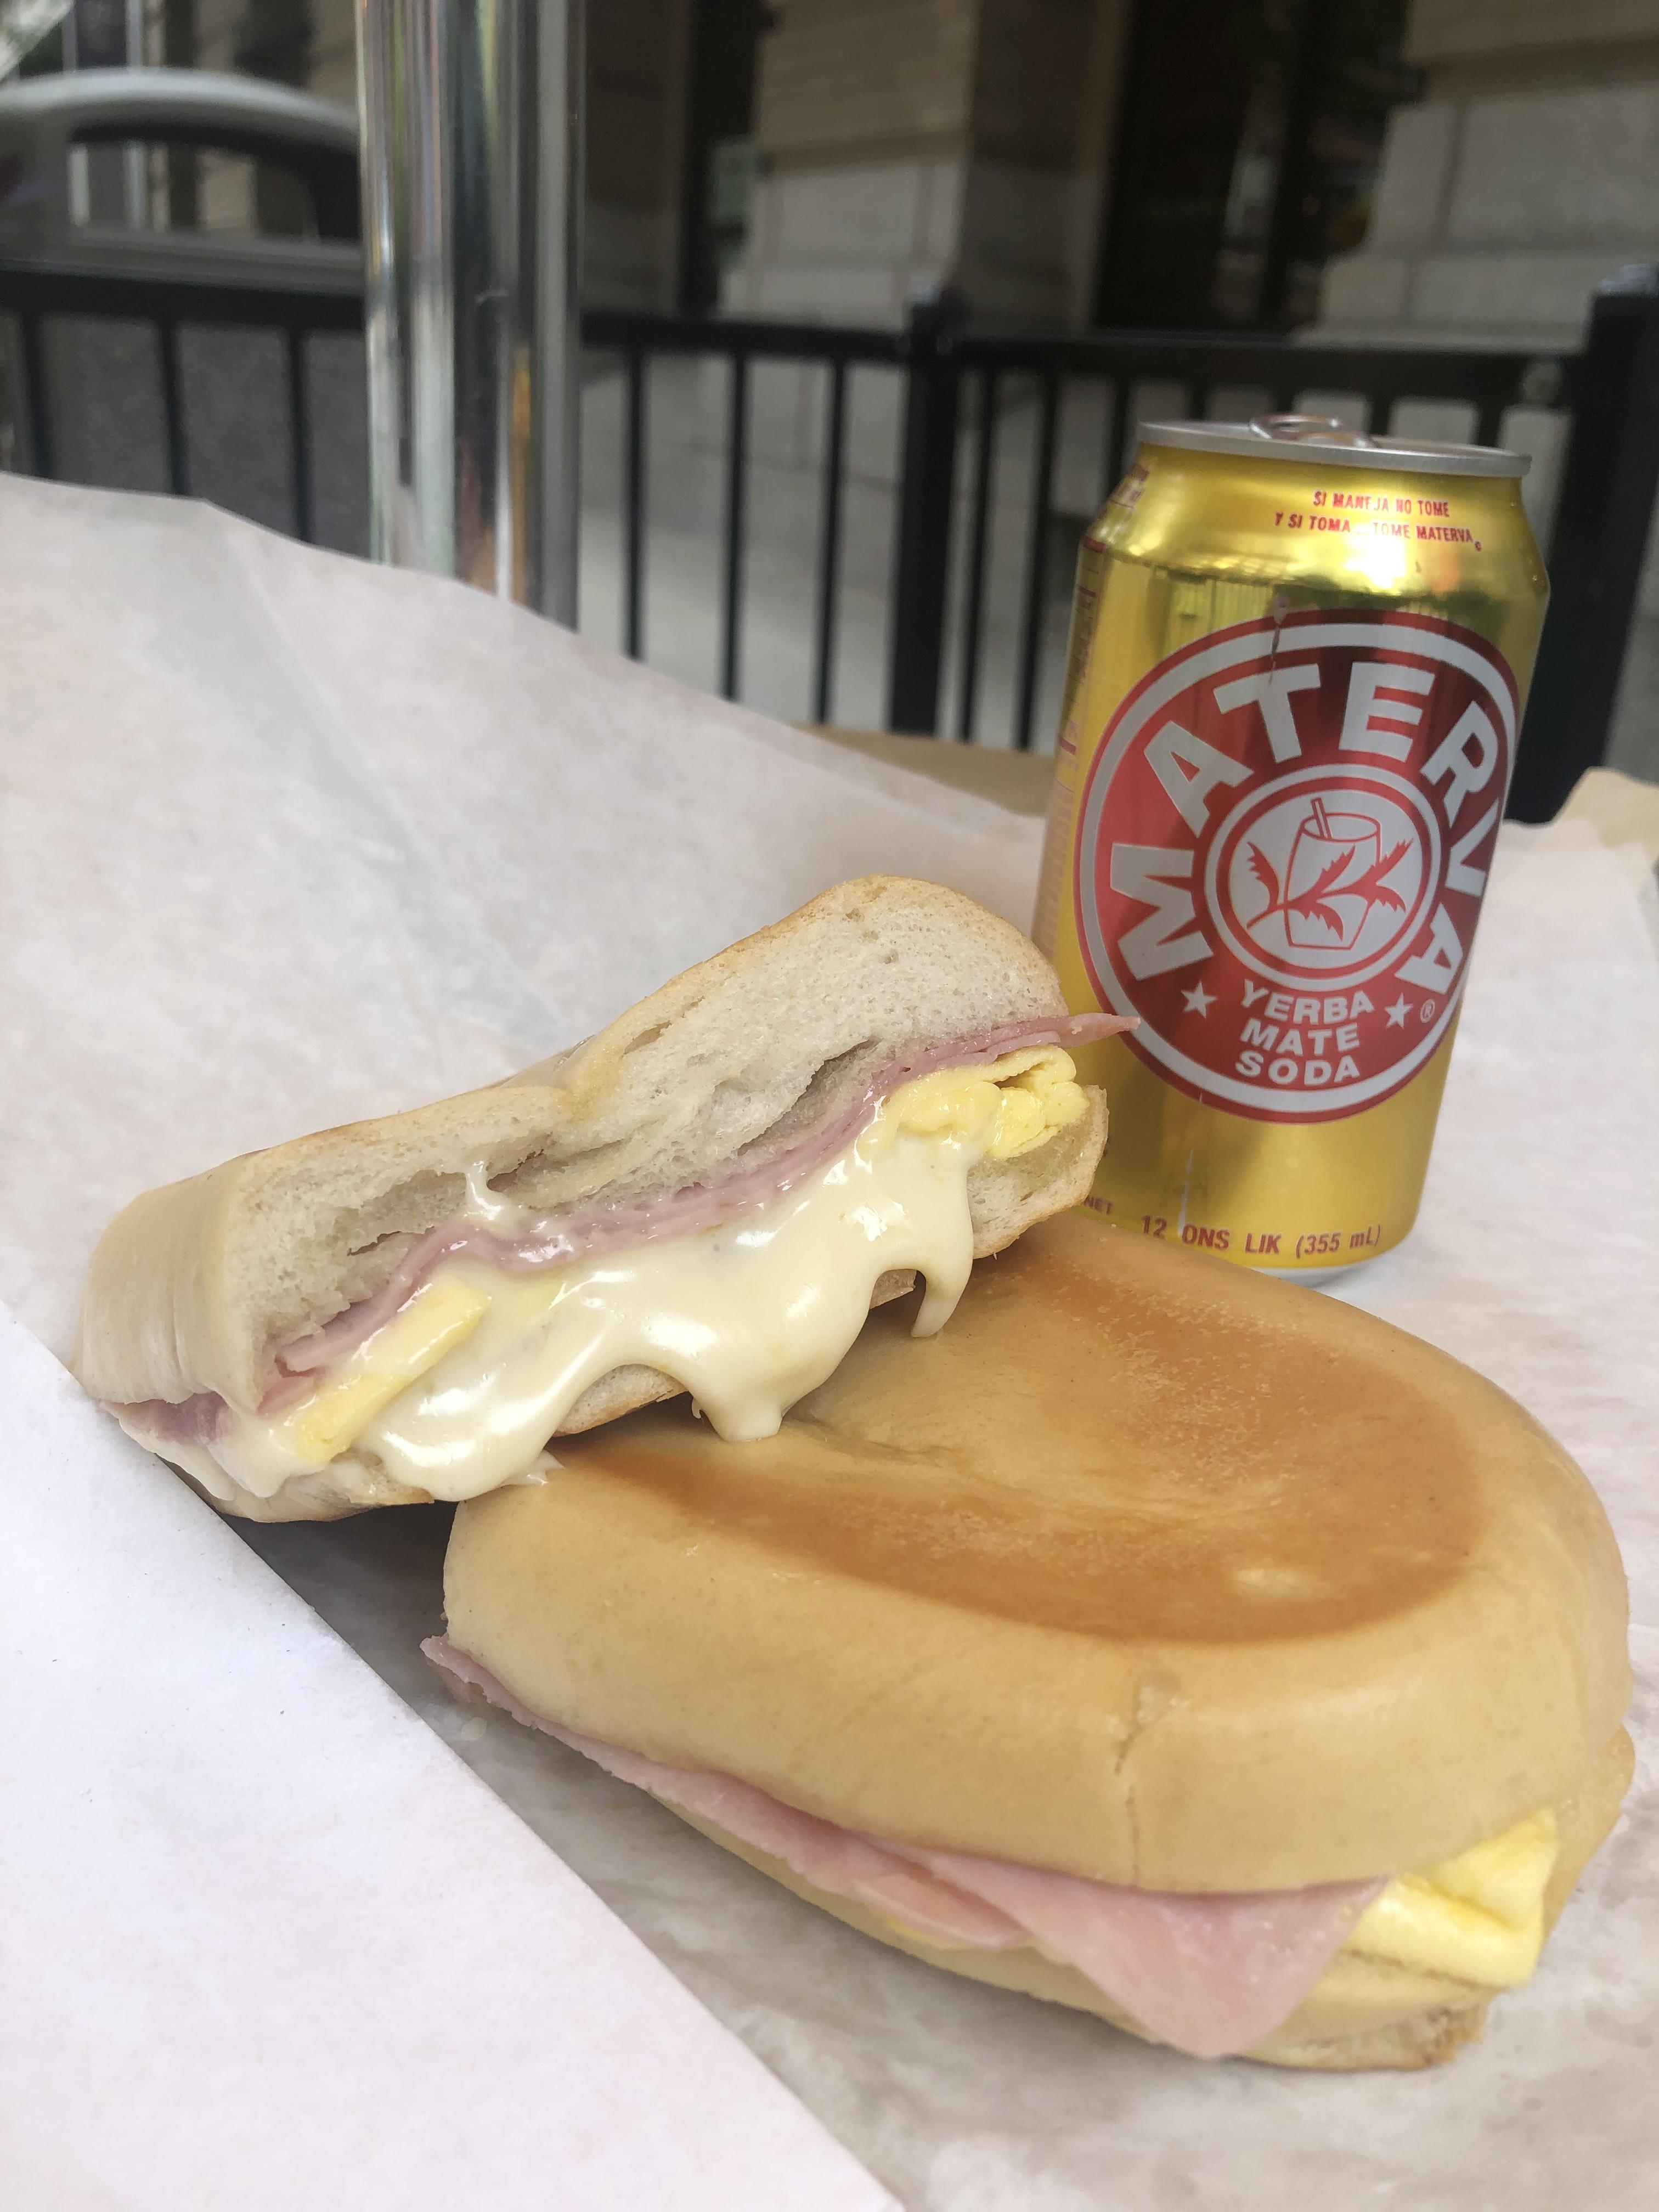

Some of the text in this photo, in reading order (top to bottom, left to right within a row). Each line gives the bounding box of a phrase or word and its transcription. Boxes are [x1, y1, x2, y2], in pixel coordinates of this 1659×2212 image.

[1313, 490, 1327, 507] SI
[1396, 499, 1412, 515] NO
[1418, 500, 1450, 517] TOME
[1274, 511, 1284, 526] Y
[1288, 513, 1303, 529] SI
[1373, 522, 1410, 539] TOME
[1416, 525, 1474, 543] MATERVA
[1110, 661, 1500, 994] MATERVA
[1240, 979, 1375, 1025] YERBA
[1240, 1017, 1361, 1057] MATE
[1235, 1050, 1361, 1086] SODA
[1142, 1214, 1168, 1240] 12
[1181, 1222, 1231, 1251] ONS
[1244, 1232, 1283, 1255] LIK
[1295, 1231, 1341, 1260] (355
[1348, 1224, 1383, 1250] mL)
